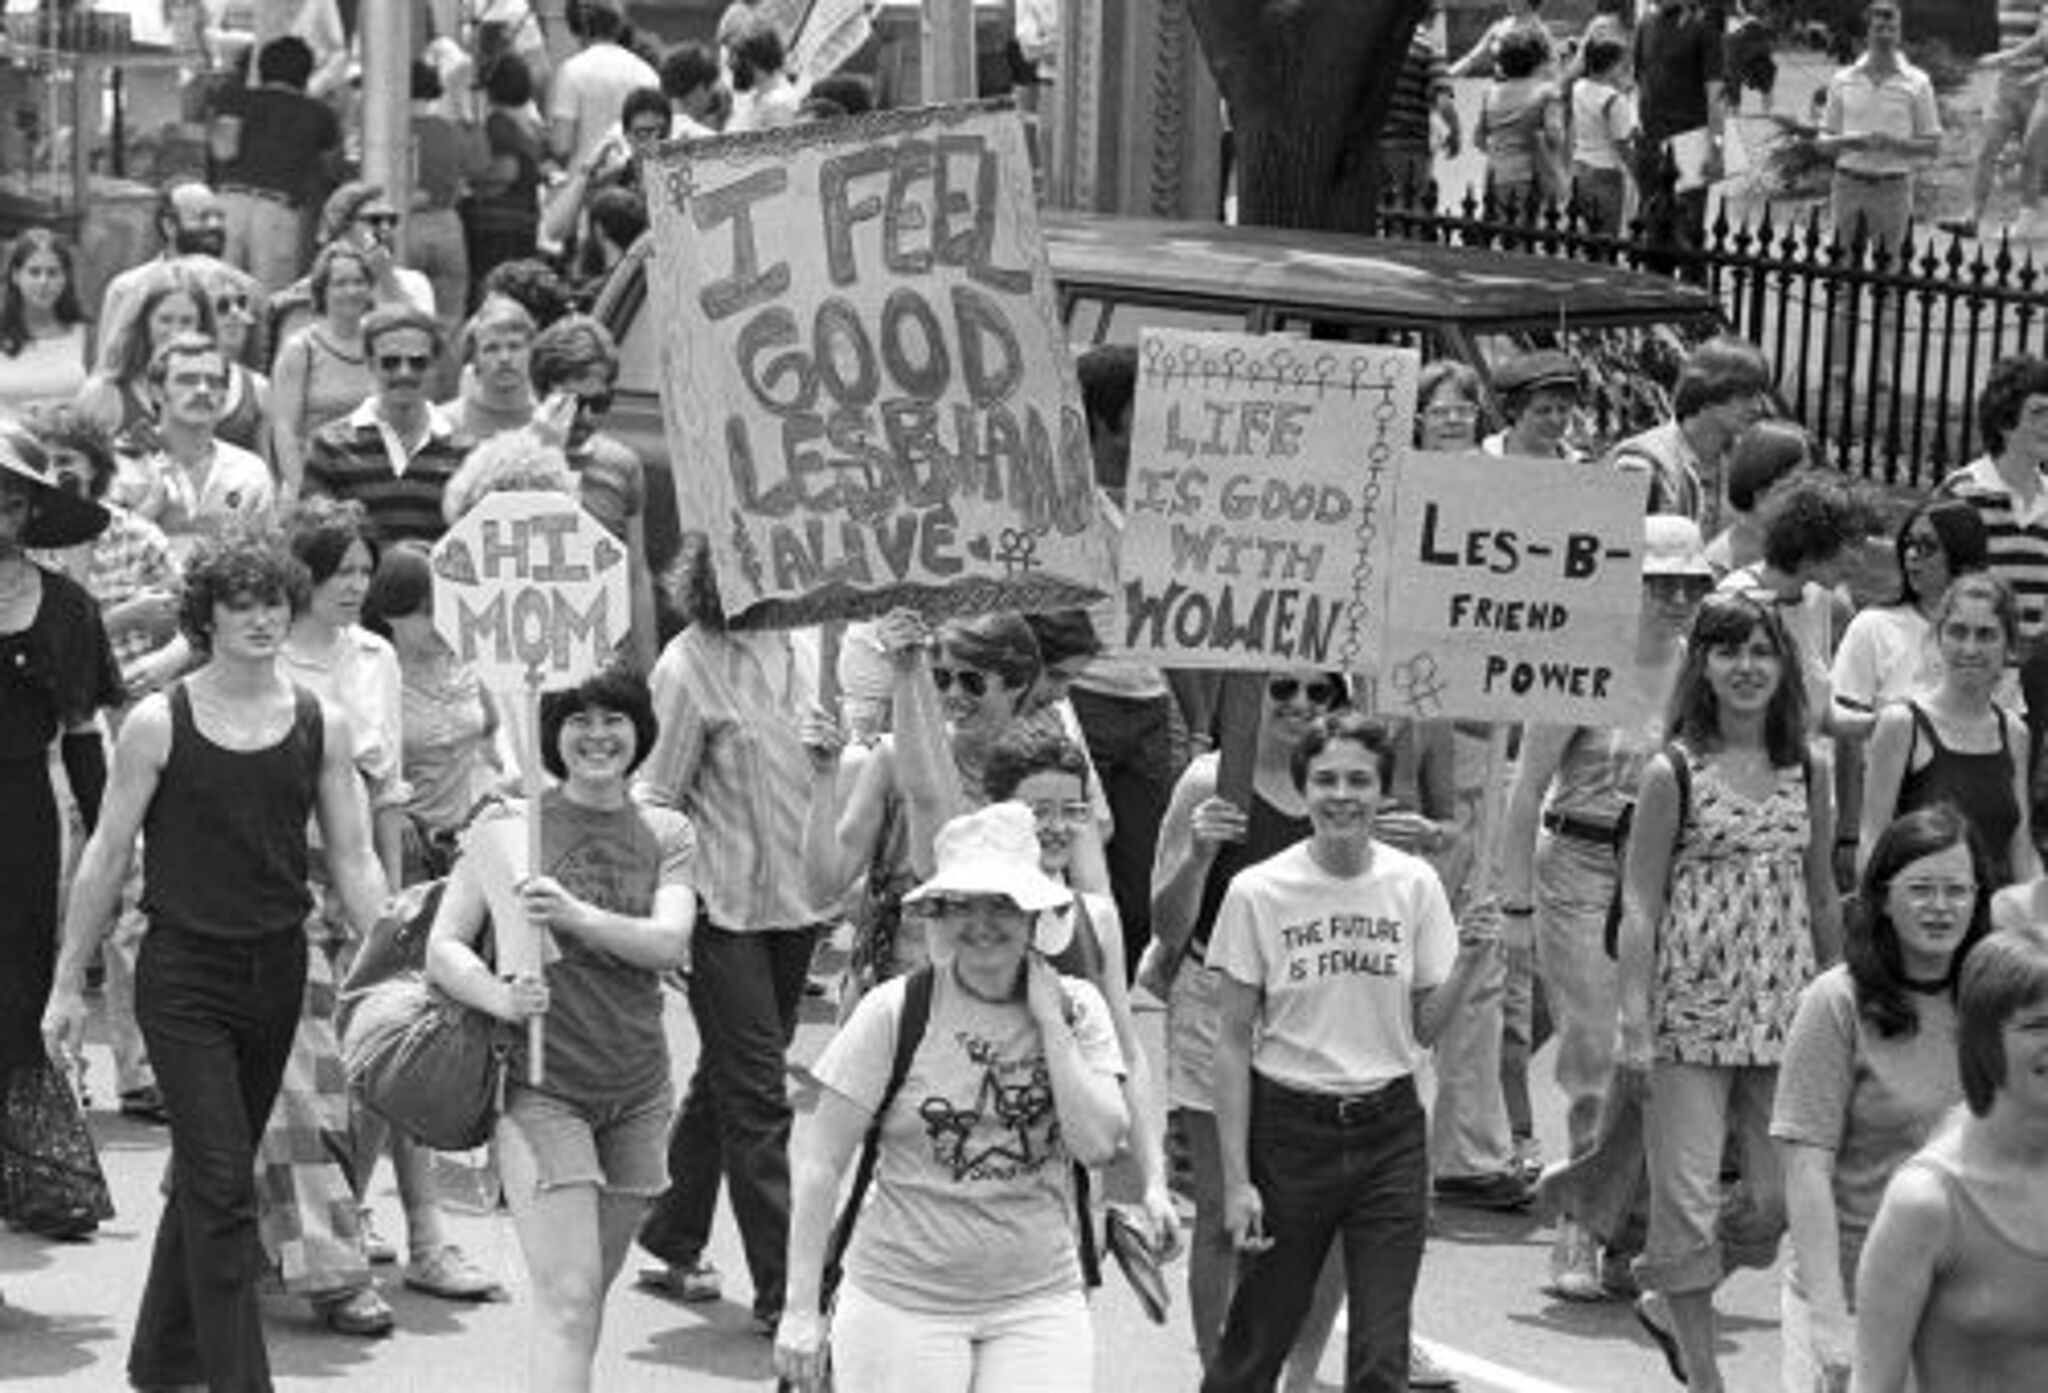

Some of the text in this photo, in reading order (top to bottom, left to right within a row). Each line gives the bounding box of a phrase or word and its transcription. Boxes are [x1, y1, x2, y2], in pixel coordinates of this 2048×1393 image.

[693, 135, 1032, 321] I FEEL
[737, 286, 1024, 418] GOOD
[1164, 402, 1312, 459] LIFE
[725, 399, 1092, 537] LESBIAN
[1135, 466, 1353, 534] IS GOOD
[483, 513, 591, 582] HI
[769, 503, 965, 591] ALIVE
[1172, 523, 1325, 582] WITH
[457, 585, 609, 675] MOM
[1124, 577, 1343, 663] WOMEN
[1449, 594, 1568, 632] FRIEND
[1483, 654, 1611, 698] POWER
[1282, 915, 1402, 949] THE FUTURE
[1318, 950, 1398, 976] FEMALE
